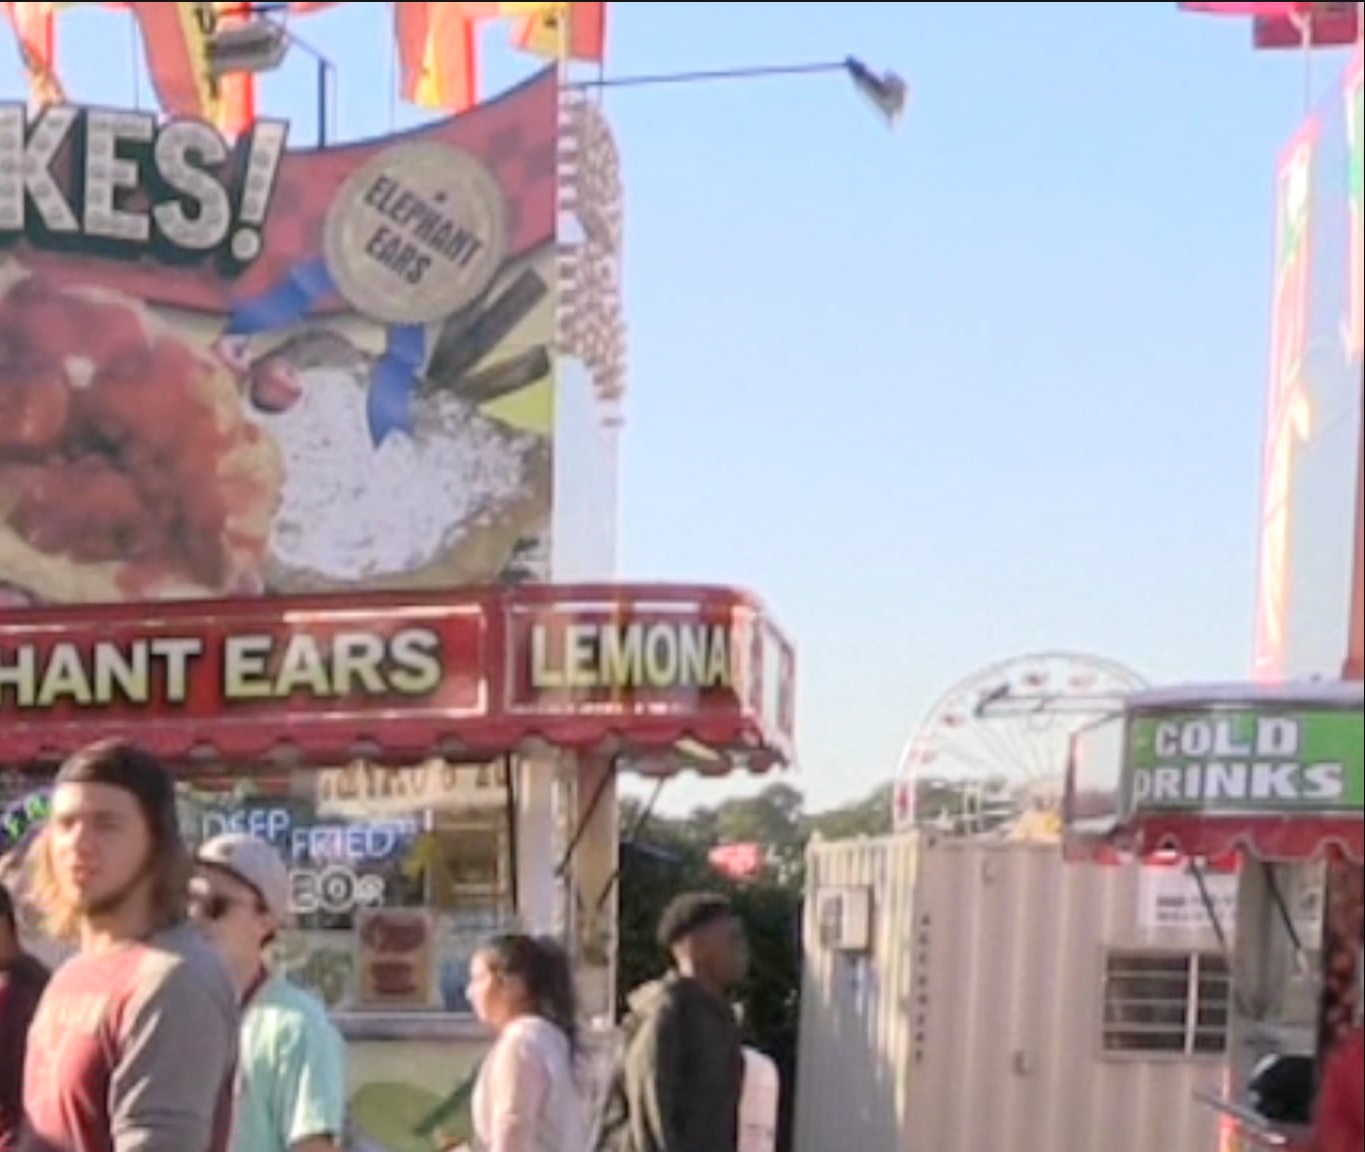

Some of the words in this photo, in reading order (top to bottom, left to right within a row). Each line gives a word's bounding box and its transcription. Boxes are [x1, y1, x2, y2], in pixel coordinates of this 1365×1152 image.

[364, 174, 483, 269] ELEPHANT
[366, 226, 432, 285] EARS
[224, 627, 442, 698] EARS
[1154, 717, 1299, 757] COLD
[1133, 762, 1344, 800] DRINKS
[291, 822, 395, 859] FRIED
